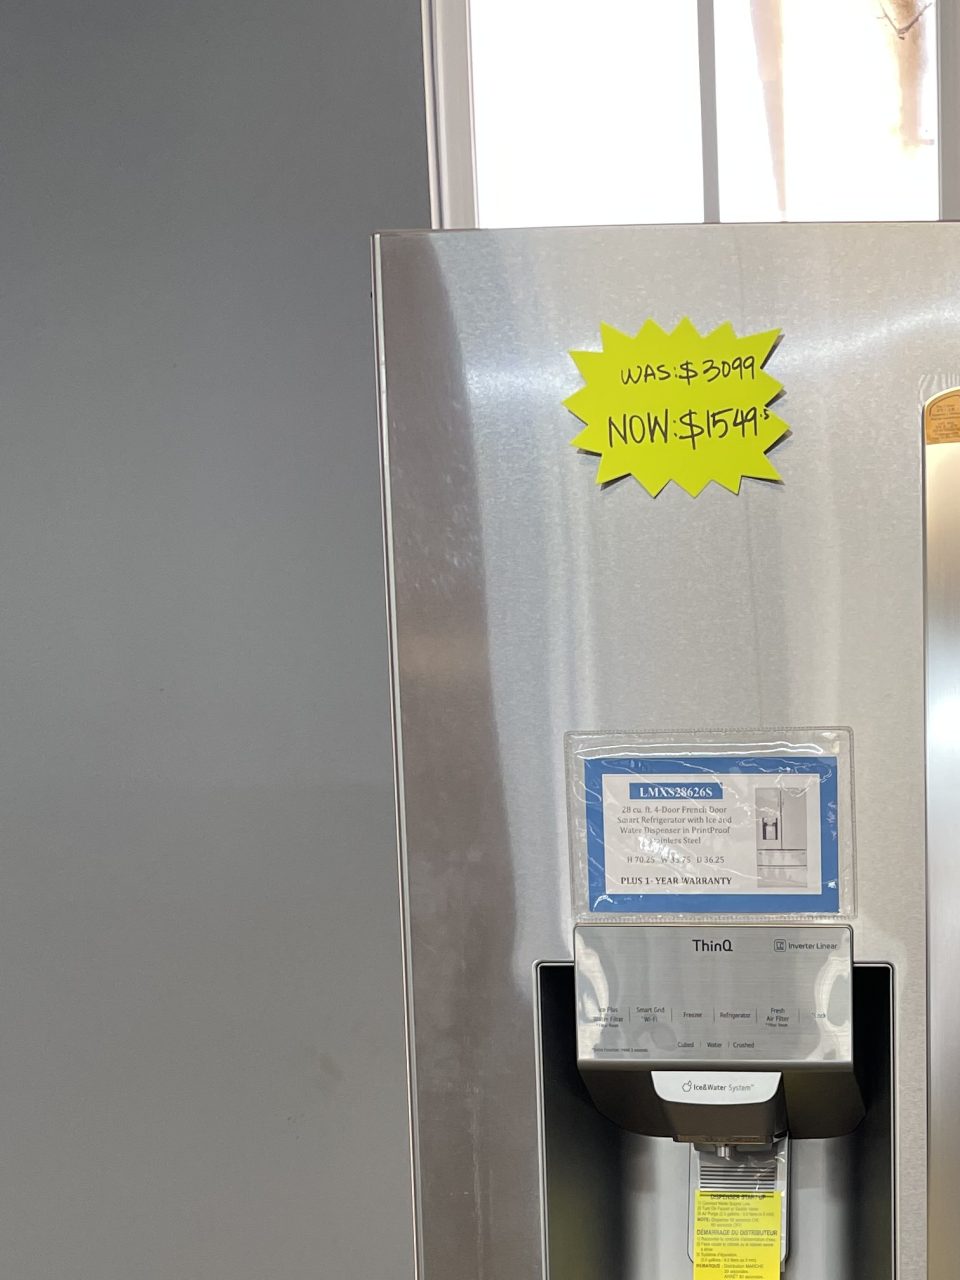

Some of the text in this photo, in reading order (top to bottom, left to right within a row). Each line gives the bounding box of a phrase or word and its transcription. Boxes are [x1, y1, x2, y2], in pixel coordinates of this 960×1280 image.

[640, 787, 713, 798] LMXS28626S
[621, 806, 632, 814] 28
[708, 806, 727, 814] Door
[641, 816, 686, 825] Refrigerator
[687, 816, 704, 824] with
[644, 827, 681, 836] Dispenser
[620, 877, 643, 885] PLUS
[655, 877, 679, 885] YEAR
[681, 877, 732, 885] WARRANTY
[692, 939, 734, 952] ThinQ
[788, 942, 838, 950] Inverter Linear
